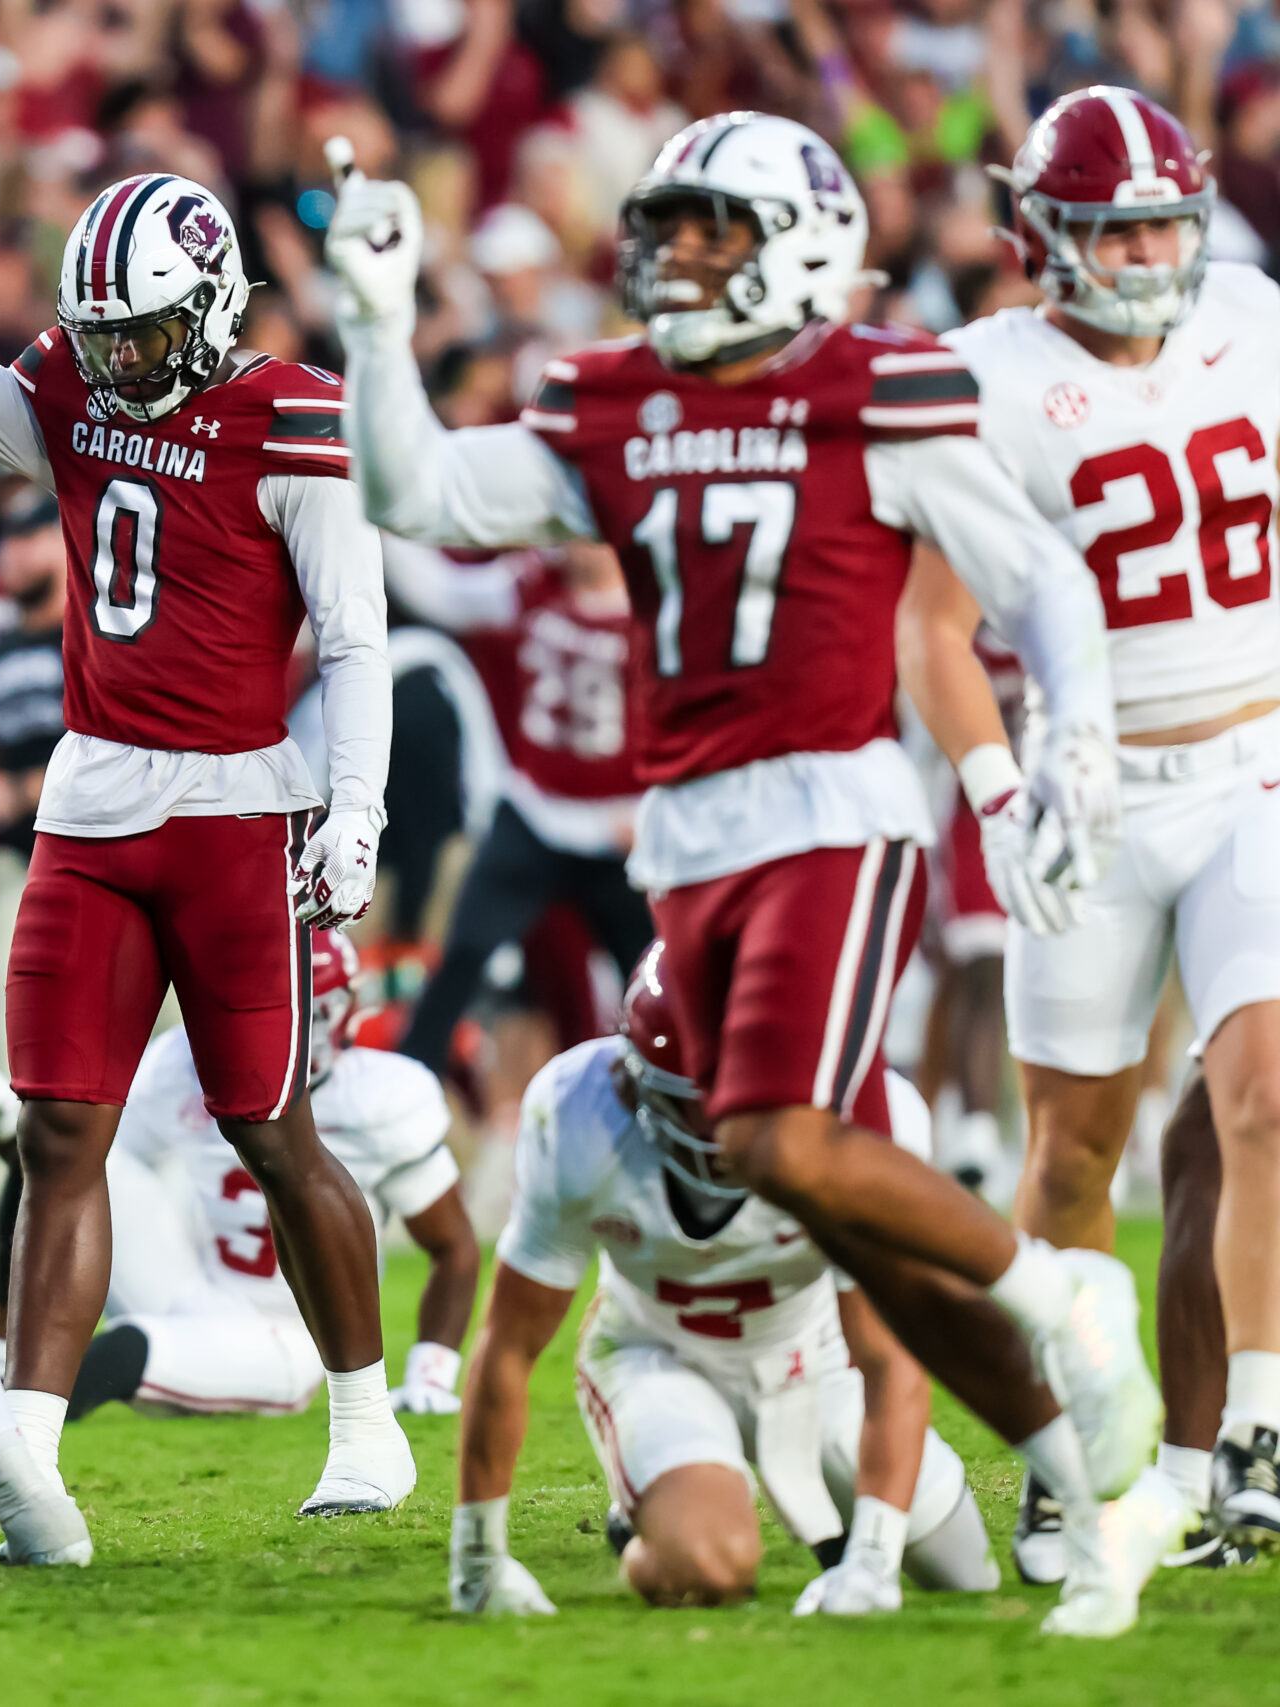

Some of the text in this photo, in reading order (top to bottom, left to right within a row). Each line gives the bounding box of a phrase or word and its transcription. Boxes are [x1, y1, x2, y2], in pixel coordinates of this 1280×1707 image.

[72, 421, 207, 483] CAROLINA
[126, 402, 154, 413] Riddll
[624, 427, 808, 481] CAROLINA
[89, 474, 164, 645] 0
[632, 480, 796, 677] 17
[1070, 416, 1273, 631] 26
